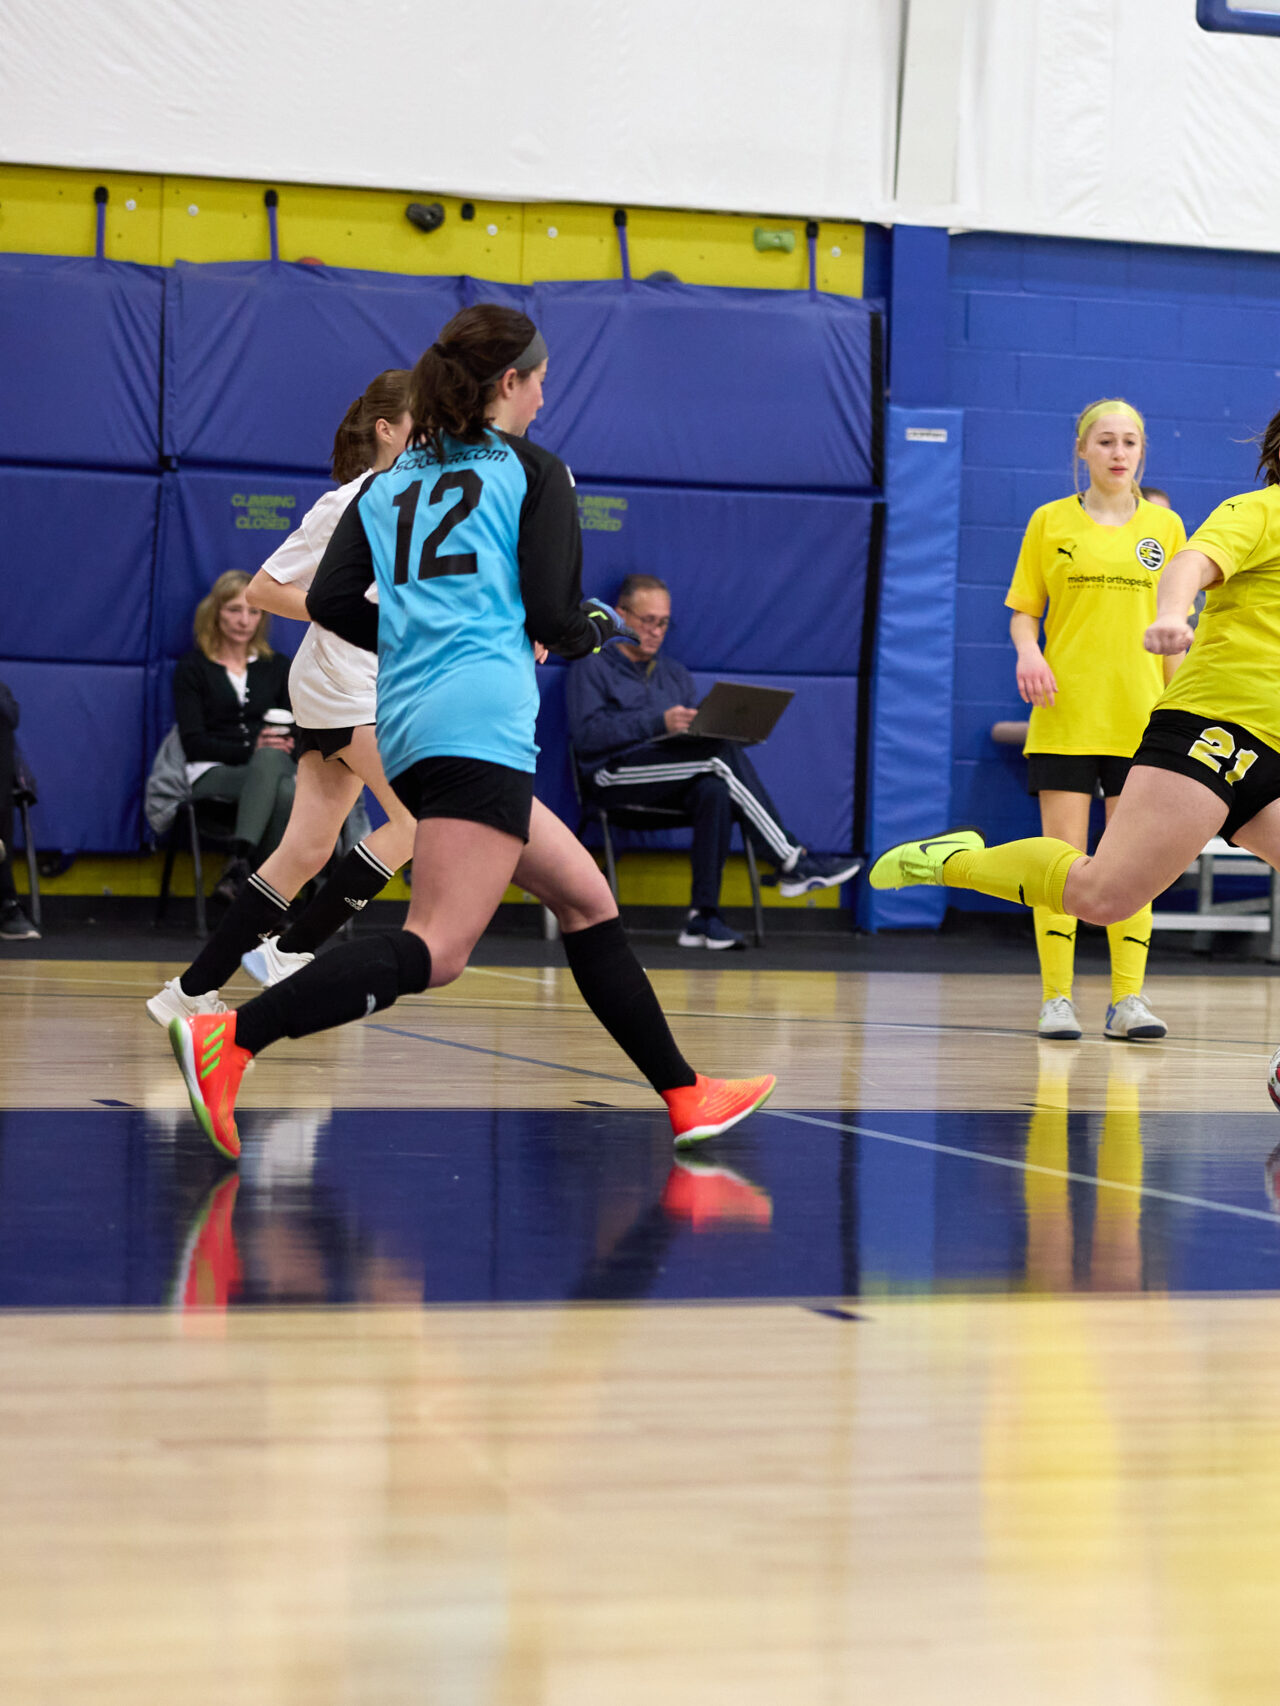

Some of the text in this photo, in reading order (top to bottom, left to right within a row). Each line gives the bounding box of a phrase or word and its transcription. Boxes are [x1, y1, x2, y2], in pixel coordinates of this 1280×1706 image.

[235, 516, 291, 531] CLOSED
[392, 468, 484, 586] 12
[1066, 573, 1105, 584] midwest
[1187, 726, 1259, 787] 21
